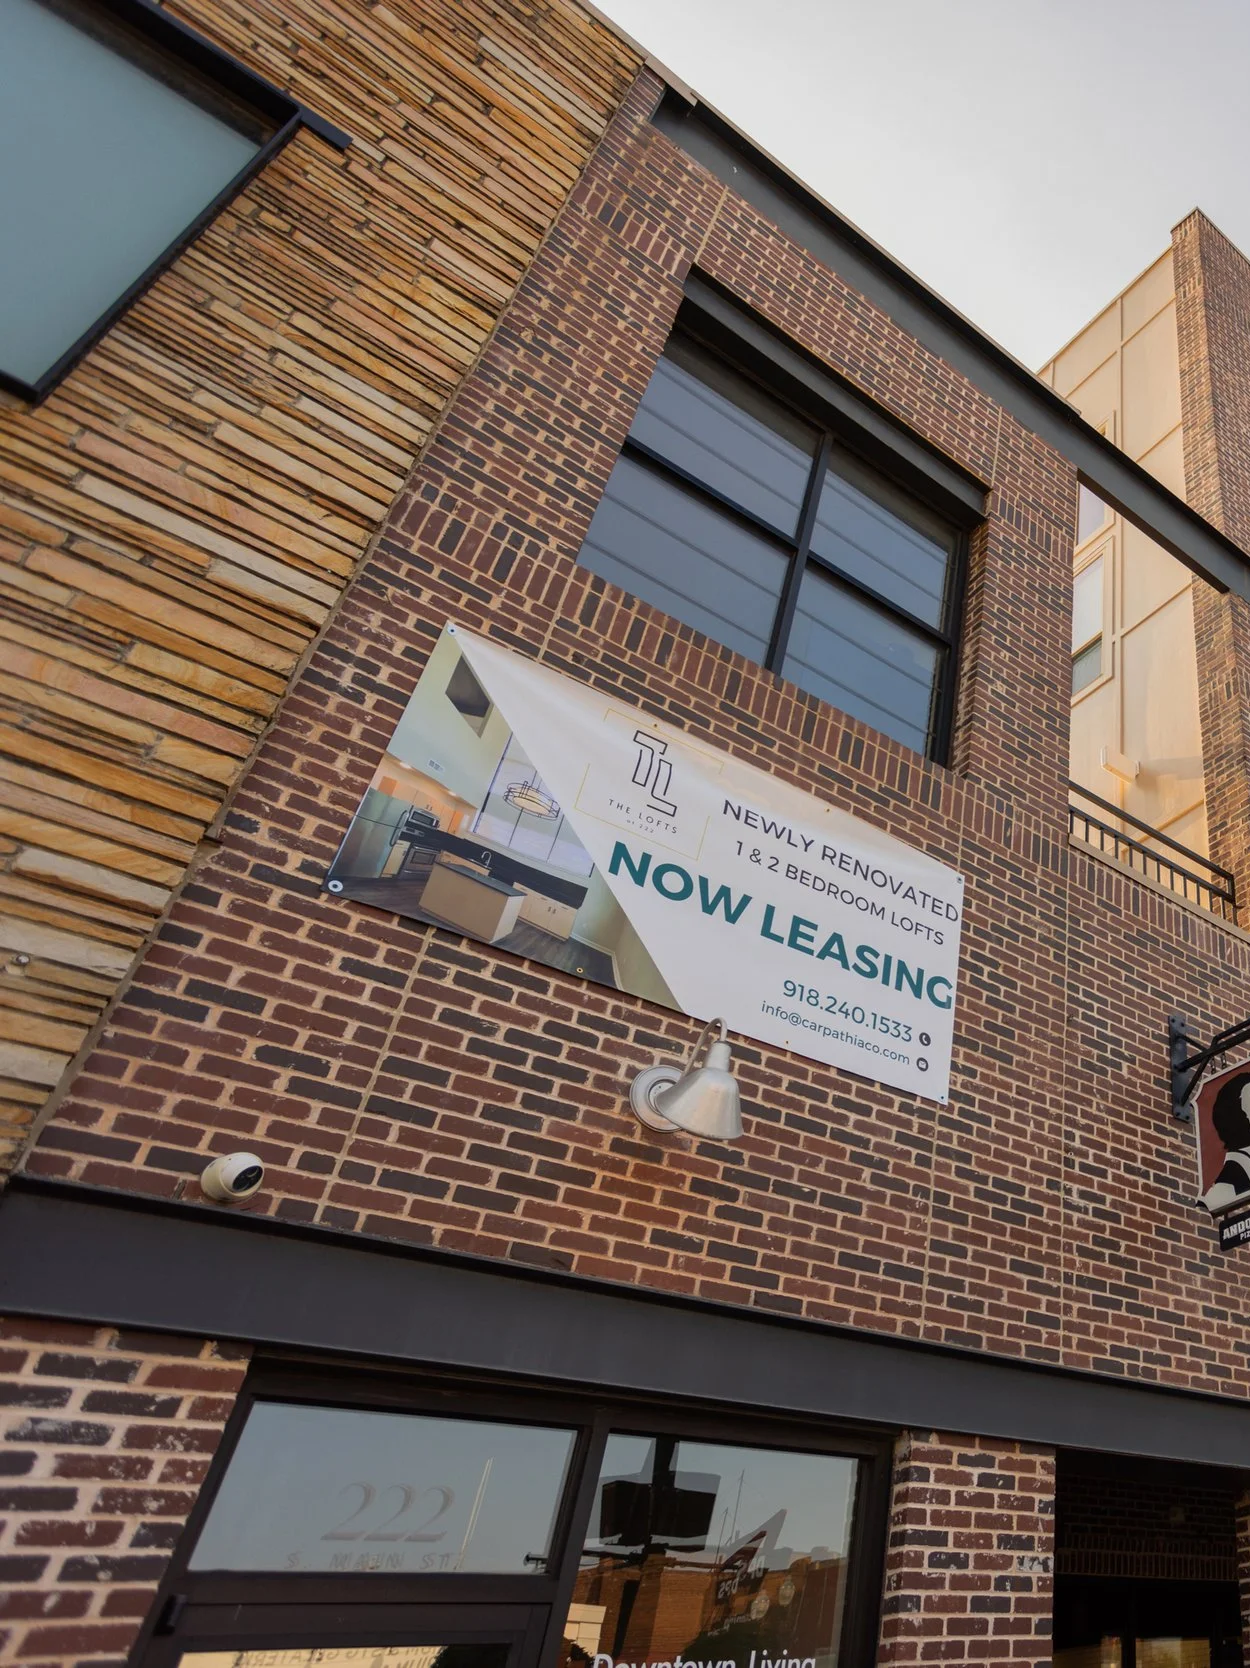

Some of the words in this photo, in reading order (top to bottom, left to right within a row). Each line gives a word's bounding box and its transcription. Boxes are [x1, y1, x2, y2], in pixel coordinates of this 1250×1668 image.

[608, 798, 631, 815] THE
[638, 812, 678, 834] LOFTS
[722, 799, 815, 854] NEWLY
[821, 845, 960, 923] RENOVATED
[735, 840, 743, 857] 1
[749, 847, 763, 866] &
[767, 855, 780, 874] 2
[785, 862, 886, 922] BEDROOM
[890, 911, 944, 946] LOFTS
[607, 840, 753, 926] NOW
[759, 904, 953, 1010] LEASING
[761, 1000, 911, 1066] info@carpathiaco.com
[782, 979, 914, 1043] 918.240.1533
[319, 1480, 456, 1542] 222
